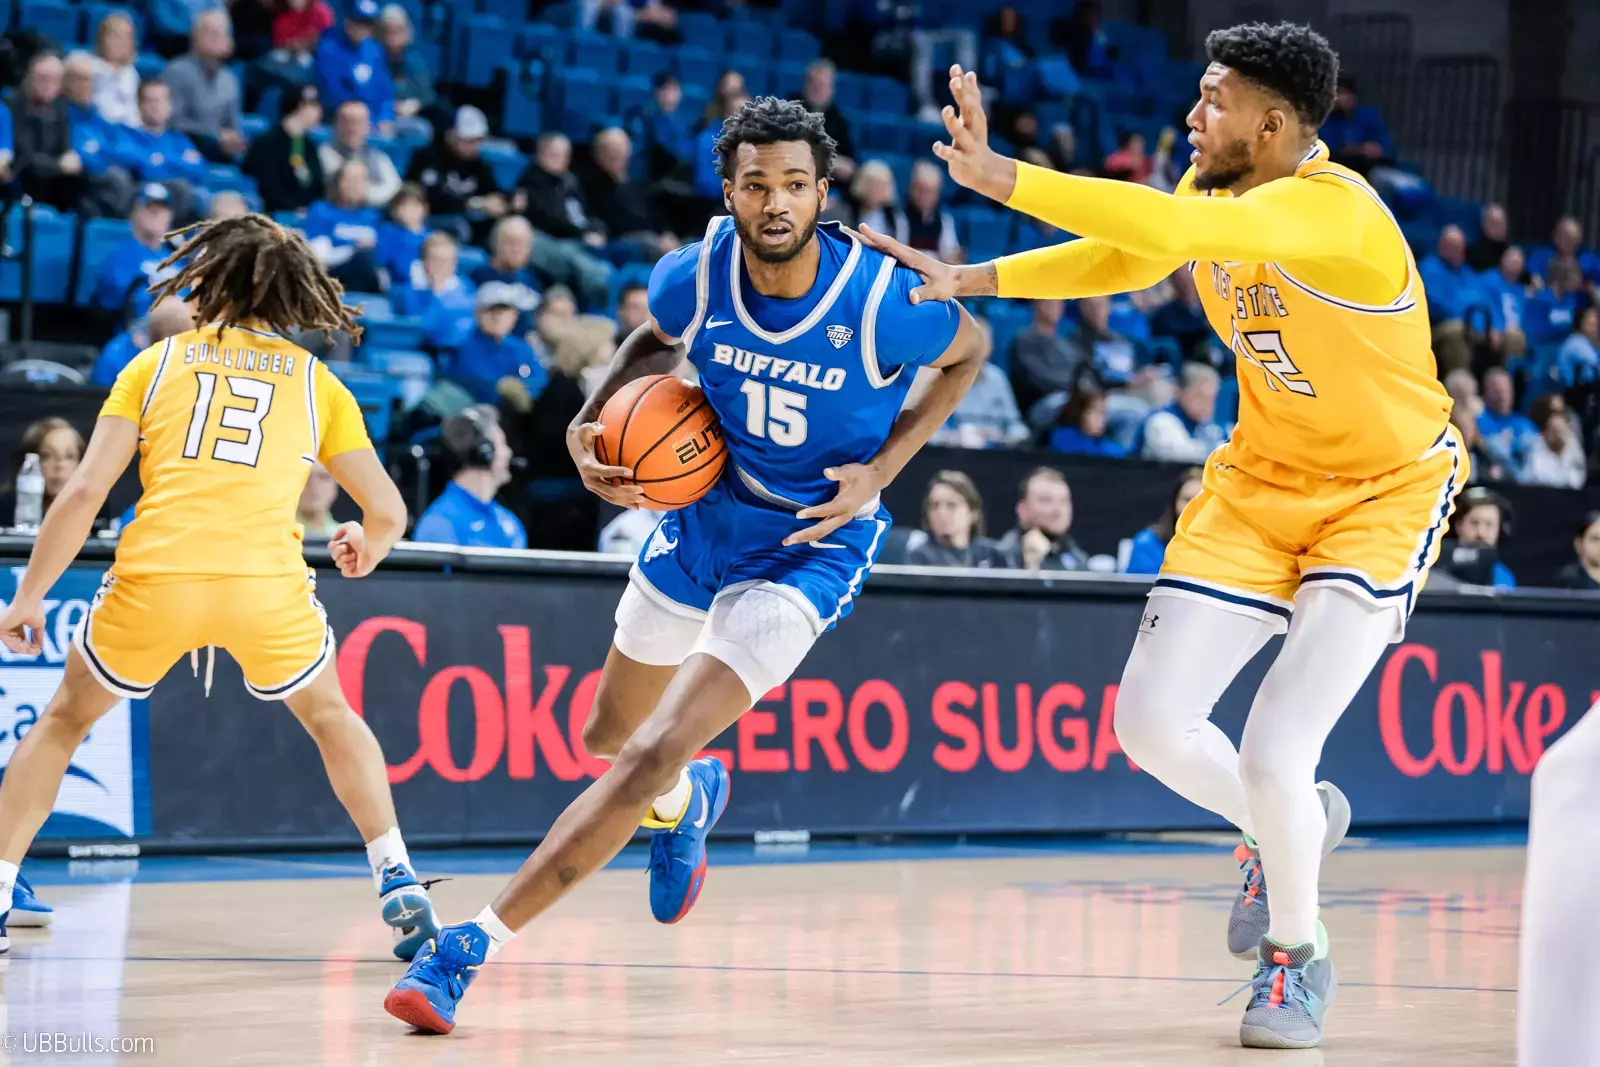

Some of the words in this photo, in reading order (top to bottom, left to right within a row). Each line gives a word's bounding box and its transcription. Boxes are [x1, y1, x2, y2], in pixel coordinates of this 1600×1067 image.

[184, 343, 296, 377] SULLINGER
[710, 342, 847, 391] BUFFALO
[182, 371, 276, 468] 13
[740, 378, 808, 447] 15
[694, 679, 909, 772] ERO
[1378, 643, 1567, 777] Coke
